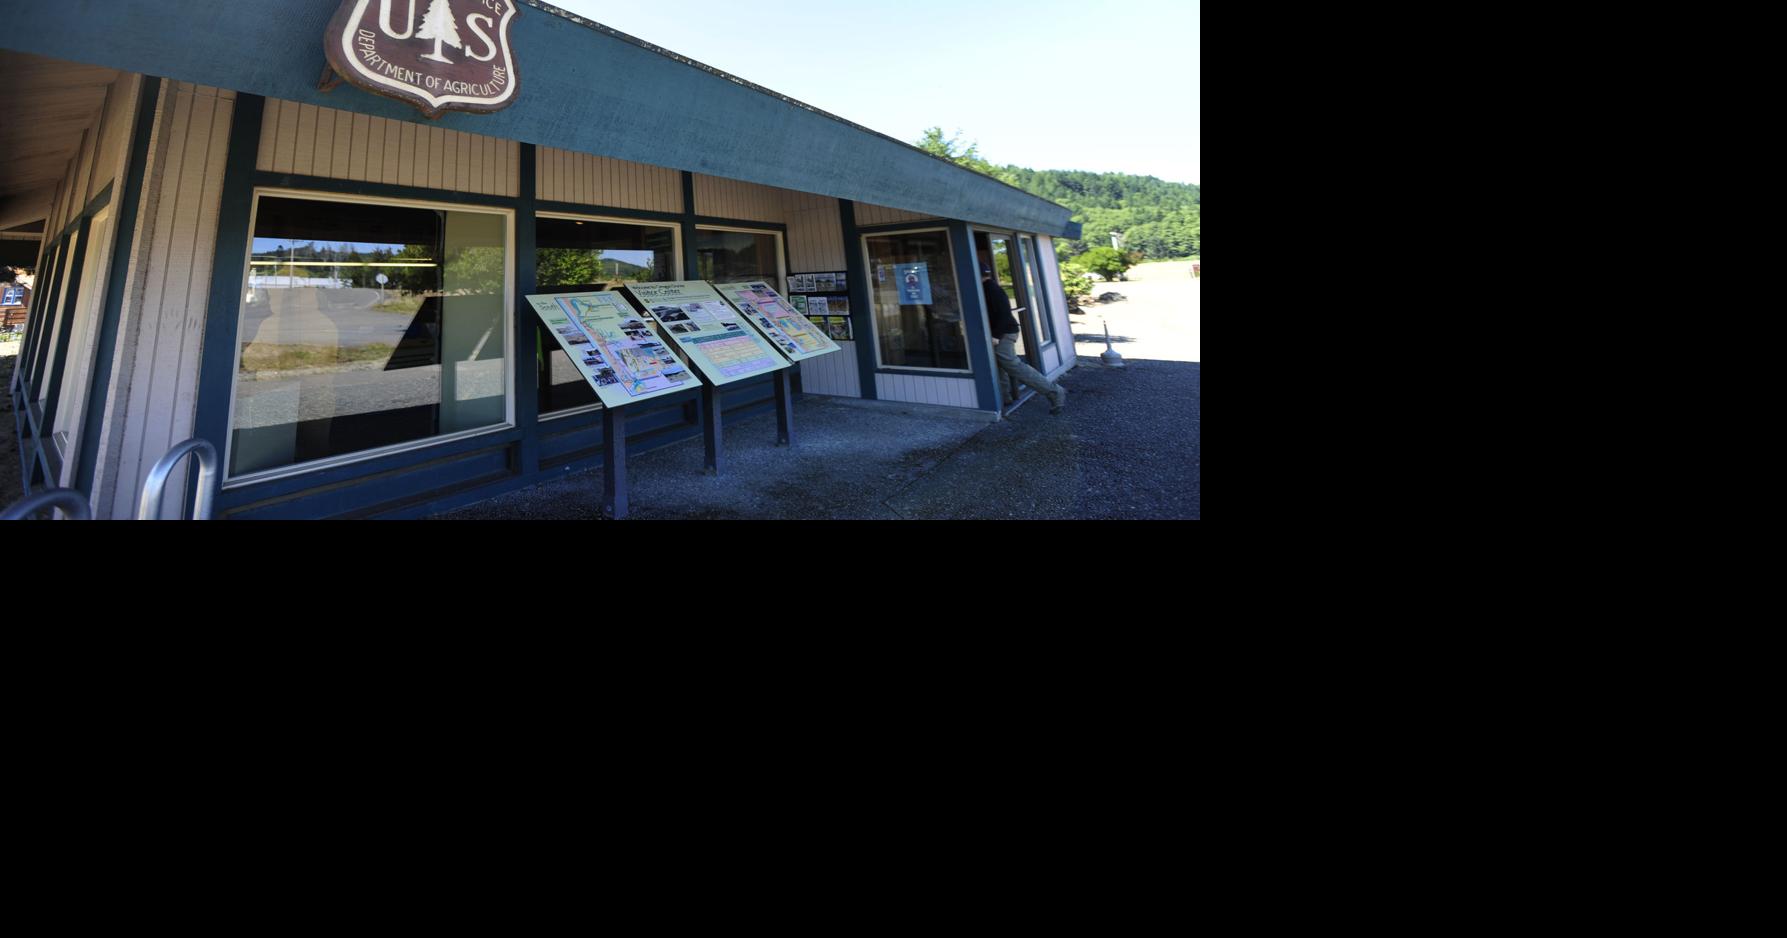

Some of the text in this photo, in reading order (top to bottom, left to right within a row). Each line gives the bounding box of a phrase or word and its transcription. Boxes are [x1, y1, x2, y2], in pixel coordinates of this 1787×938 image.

[358, 28, 506, 97] DEPARTMENT OF AGRICULTURE
[379, 0, 497, 61] U S
